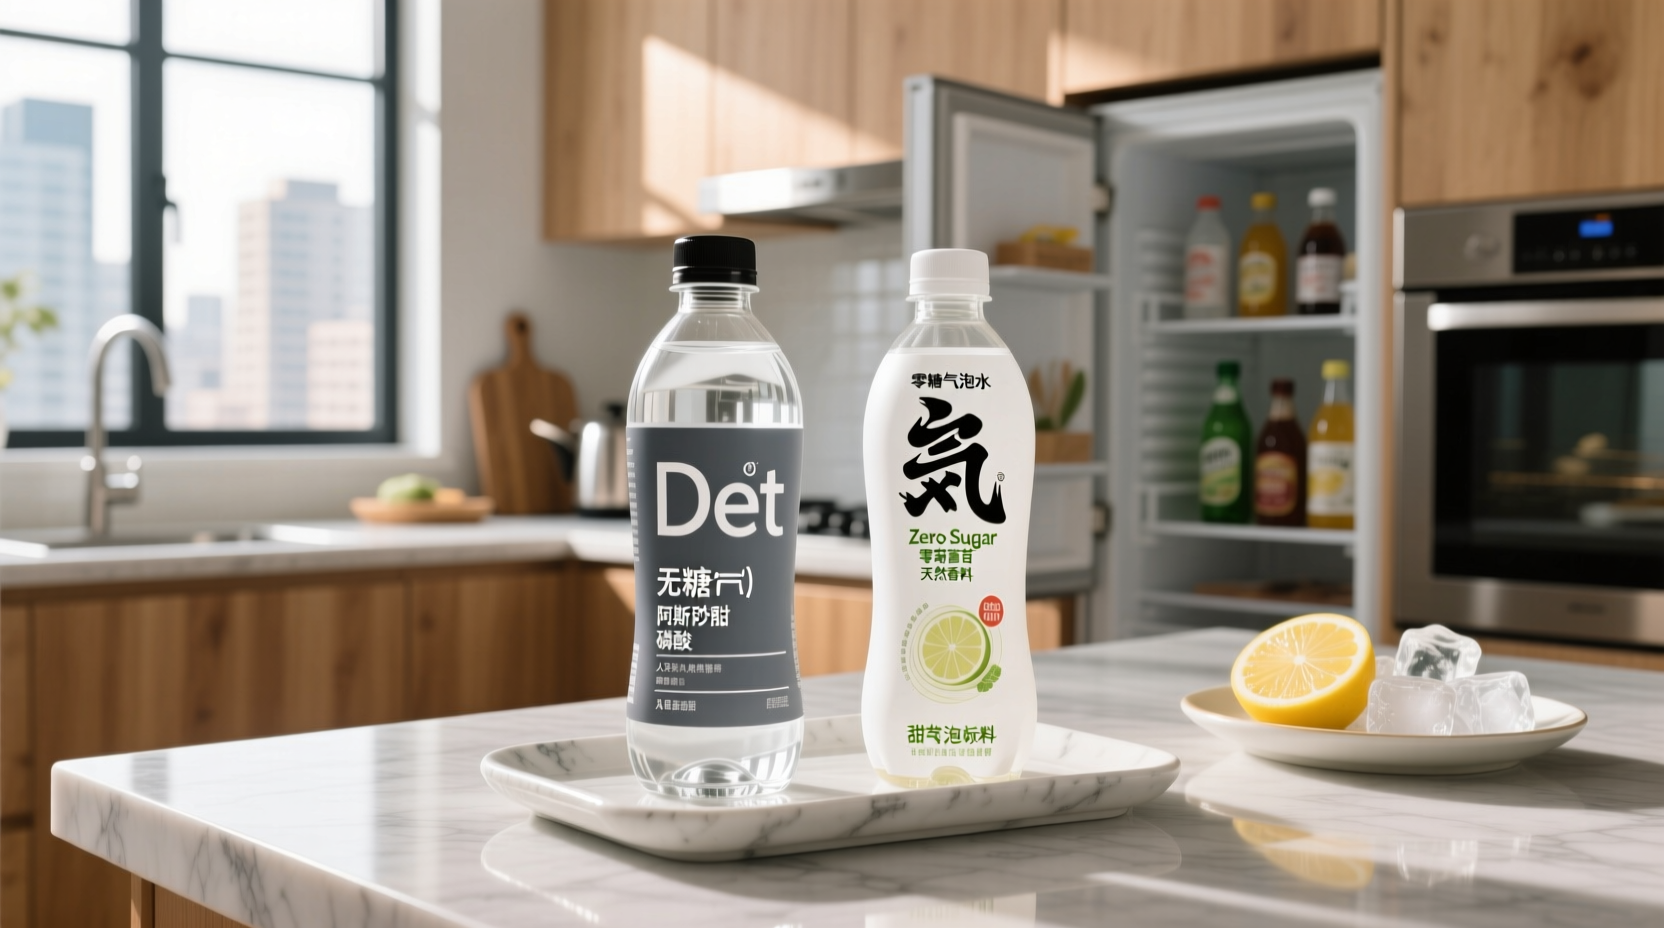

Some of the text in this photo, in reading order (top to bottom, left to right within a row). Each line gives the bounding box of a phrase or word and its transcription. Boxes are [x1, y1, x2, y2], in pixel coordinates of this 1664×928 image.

[657, 462, 784, 537] Det
[908, 529, 997, 549] Zero Sugar
